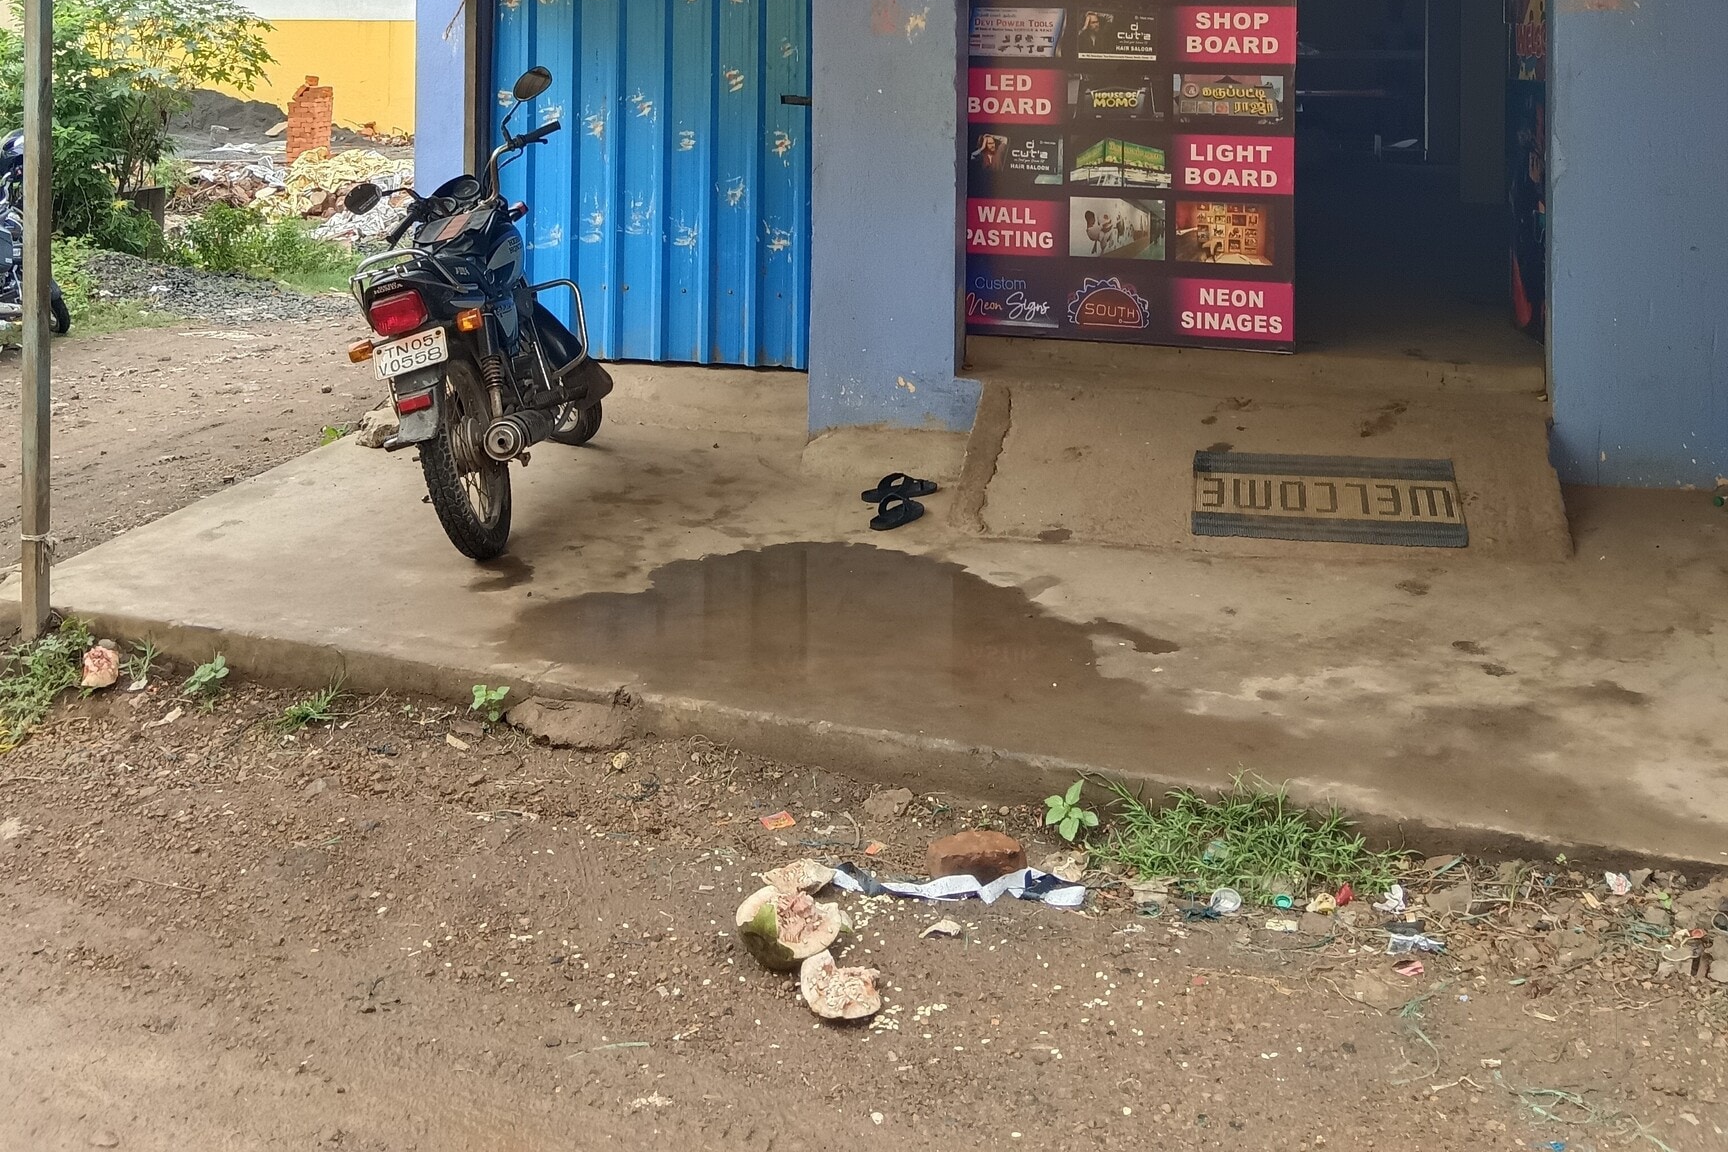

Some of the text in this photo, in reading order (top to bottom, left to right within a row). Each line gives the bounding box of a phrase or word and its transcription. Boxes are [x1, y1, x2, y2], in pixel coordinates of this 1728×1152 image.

[974, 18, 1054, 28] DEVI POWER TOOLS
[1195, 12, 1269, 30] SHOP
[1186, 36, 1279, 54] BOARD
[985, 74, 1032, 91] LED
[968, 97, 1052, 115] BOARD
[1093, 98, 1138, 108] MOMO
[1190, 143, 1272, 163] LIGHT
[1185, 167, 1277, 187] BOARD
[977, 206, 1036, 224] WALL
[974, 276, 1027, 290] Custom
[966, 291, 1050, 321] Neon Signs
[1200, 287, 1264, 308] NEON
[1084, 303, 1135, 318] SOUTH
[1181, 311, 1283, 334] SINAGES
[379, 346, 442, 377] V0558
[1202, 476, 1455, 518] WELCOME
